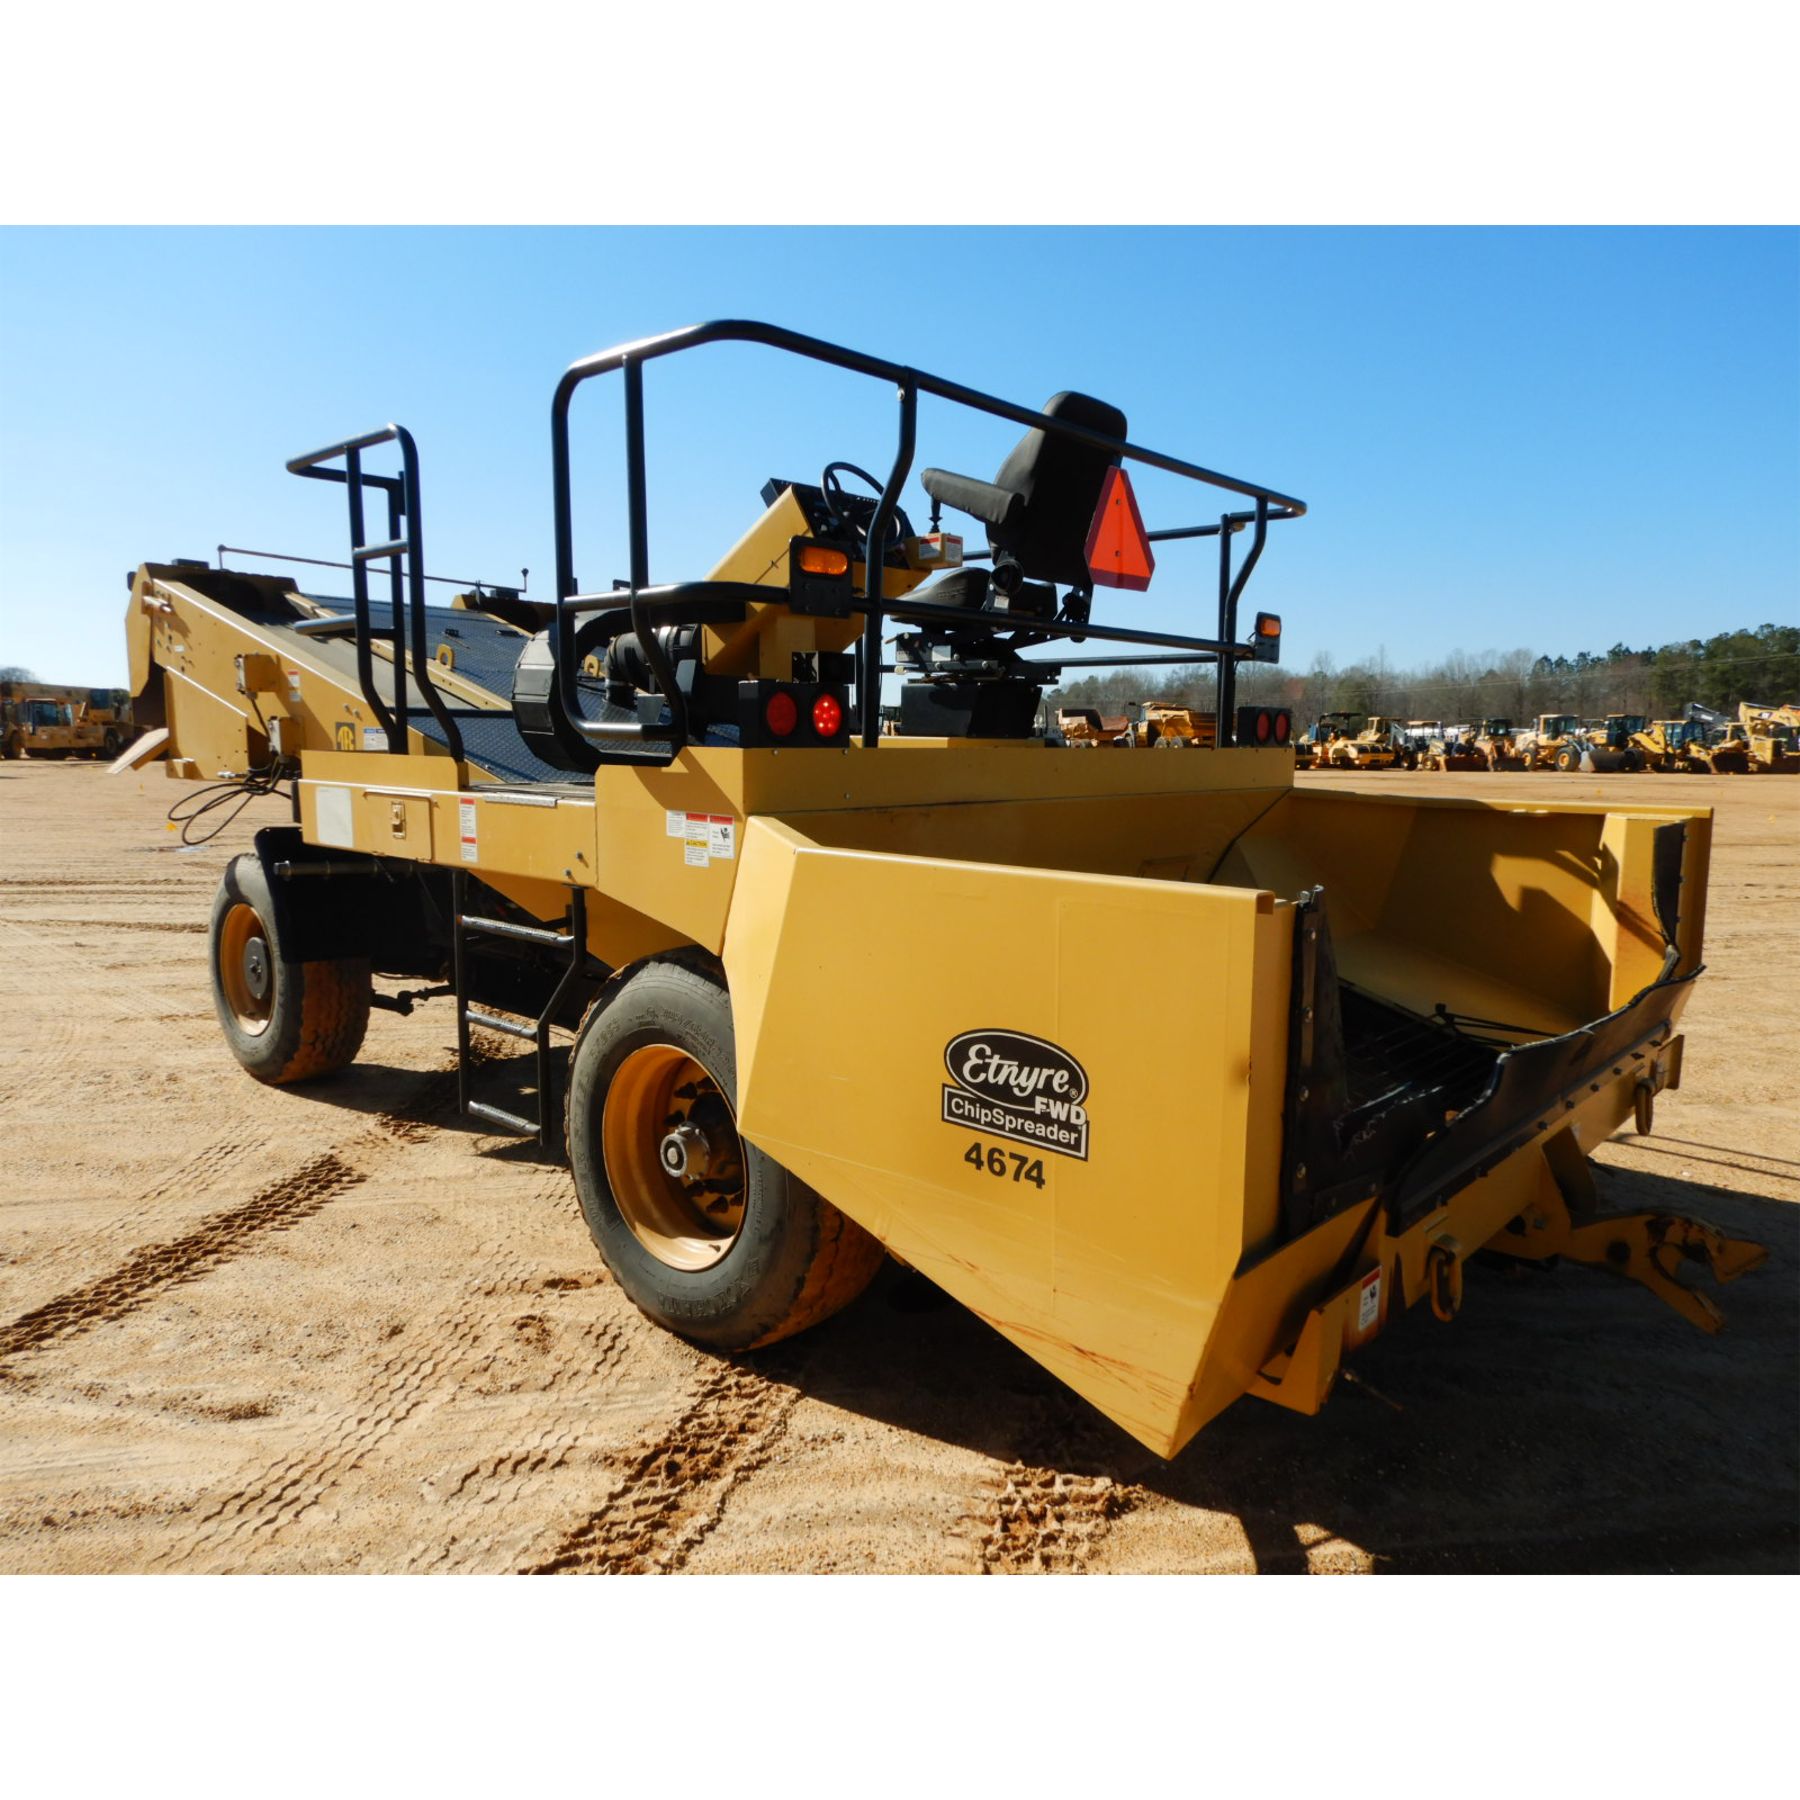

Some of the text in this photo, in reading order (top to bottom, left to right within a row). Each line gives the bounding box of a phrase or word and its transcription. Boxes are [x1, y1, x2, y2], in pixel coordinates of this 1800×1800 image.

[962, 1043, 1070, 1097] Etnyre
[951, 1097, 1079, 1145] ChipSpreader
[1034, 1095, 1086, 1126] FWD
[964, 1142, 1046, 1190] 4674
